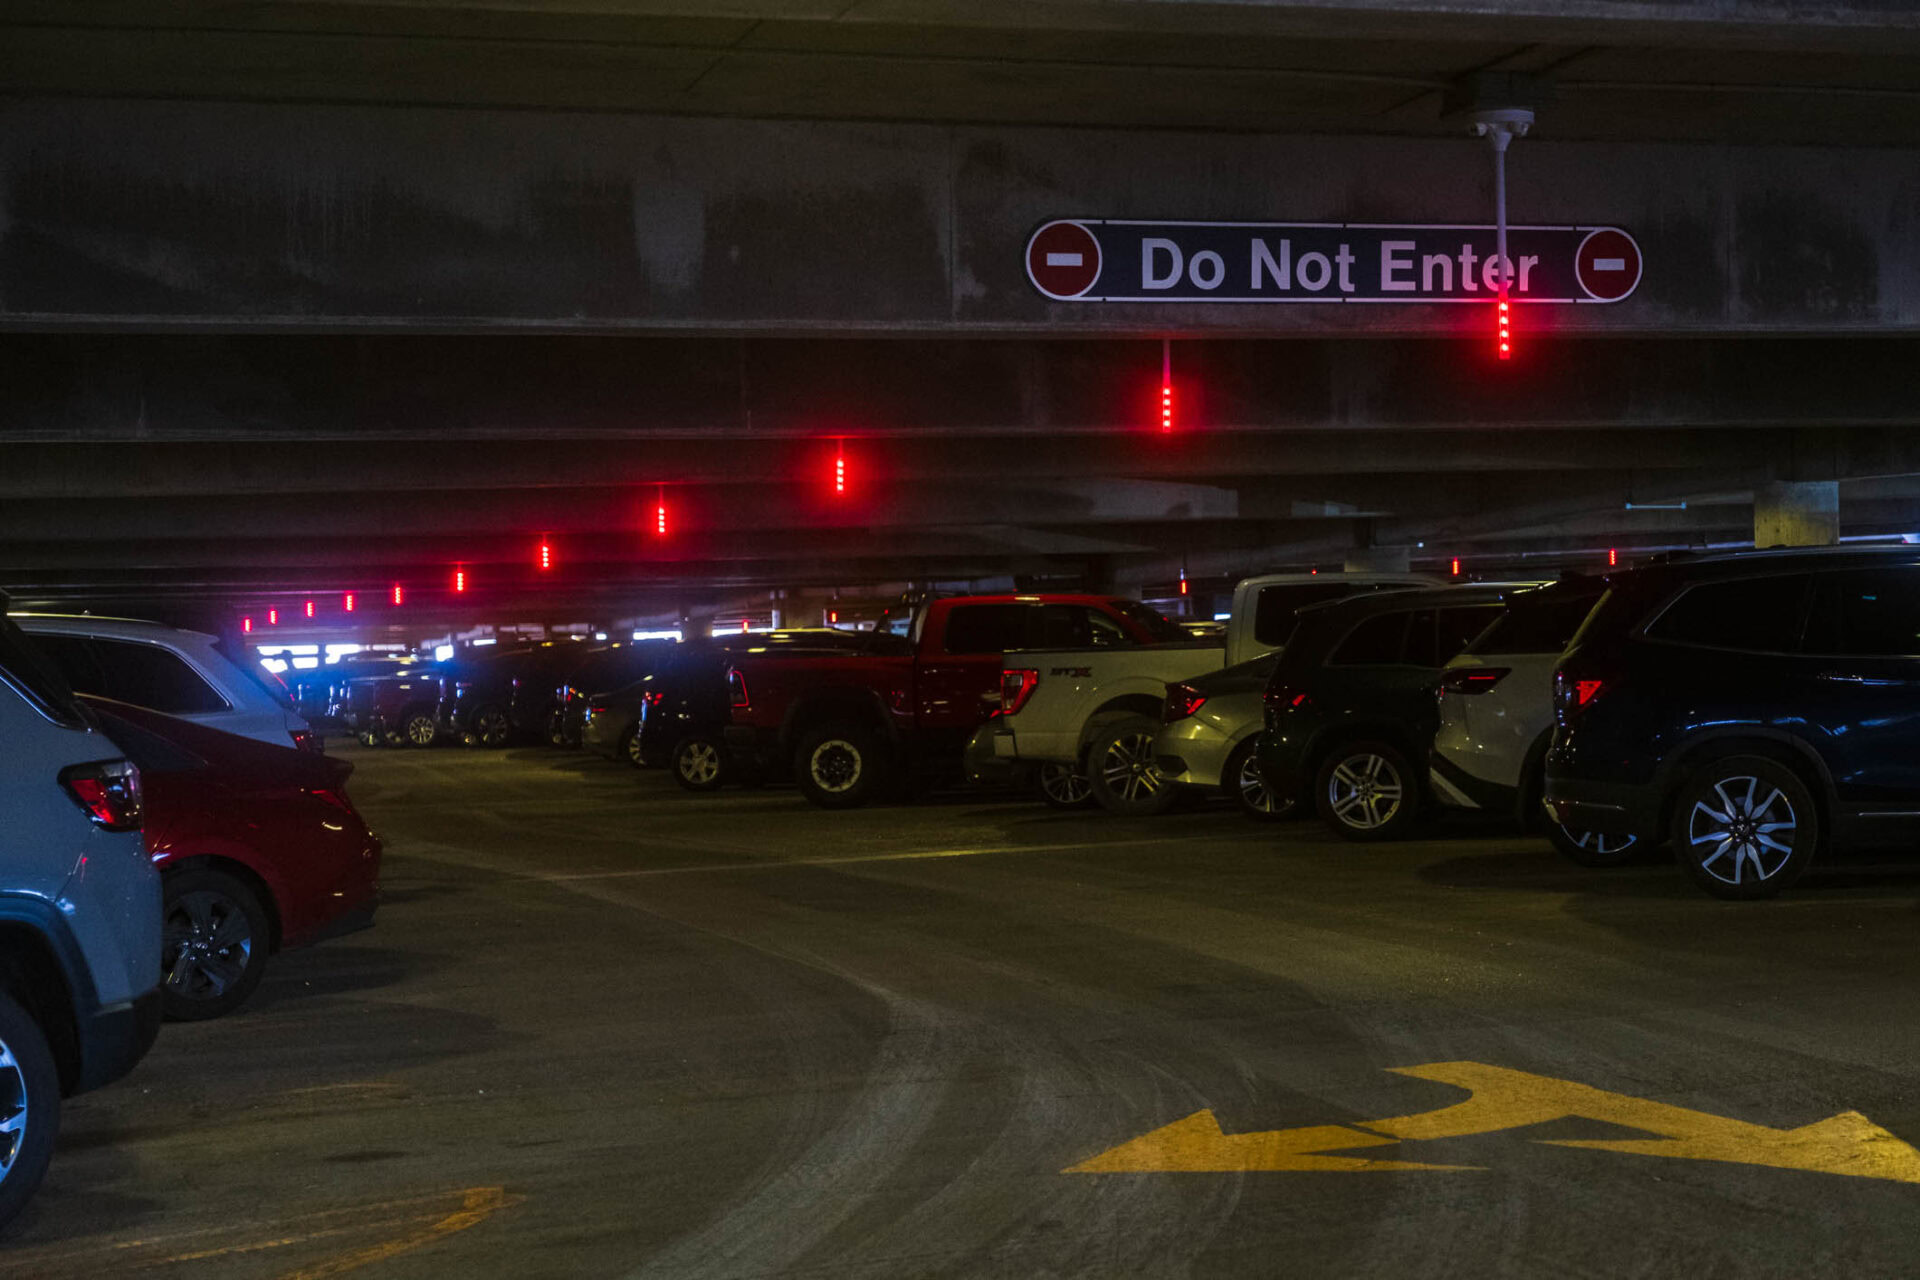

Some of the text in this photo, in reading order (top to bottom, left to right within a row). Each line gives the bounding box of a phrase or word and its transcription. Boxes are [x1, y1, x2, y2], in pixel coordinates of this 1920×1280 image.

[1141, 238, 1539, 292] Do Not Enter
